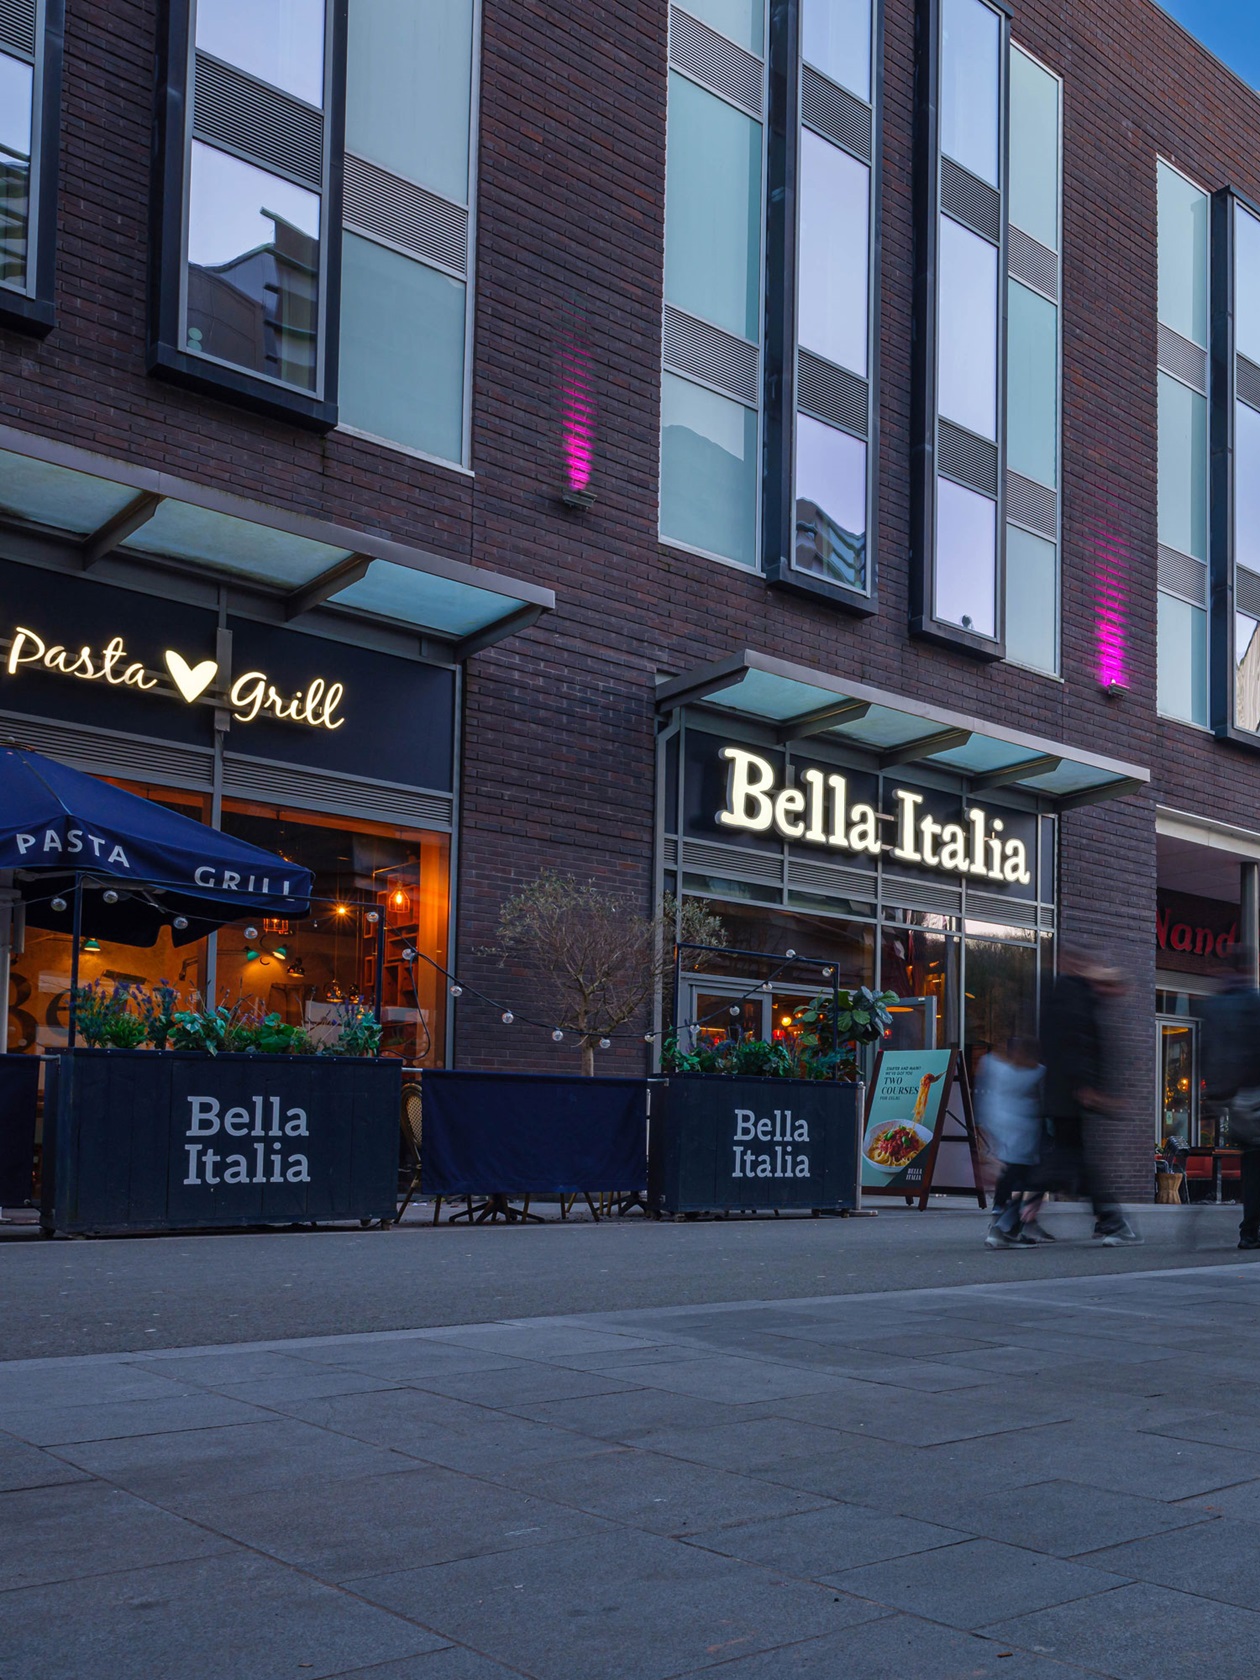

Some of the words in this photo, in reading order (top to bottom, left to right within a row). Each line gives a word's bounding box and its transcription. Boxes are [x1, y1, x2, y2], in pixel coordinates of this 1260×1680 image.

[7, 626, 158, 690] Pasta
[230, 670, 345, 730] Grill
[715, 746, 882, 855] Bella
[892, 787, 1032, 886] Italia
[16, 830, 130, 868] PASTA
[881, 1086, 919, 1095] COURSES
[884, 1076, 903, 1085] TWO
[186, 1095, 310, 1138] Bella
[733, 1109, 810, 1143] Bella
[183, 1142, 311, 1186] Italia
[731, 1145, 811, 1179] Italia
